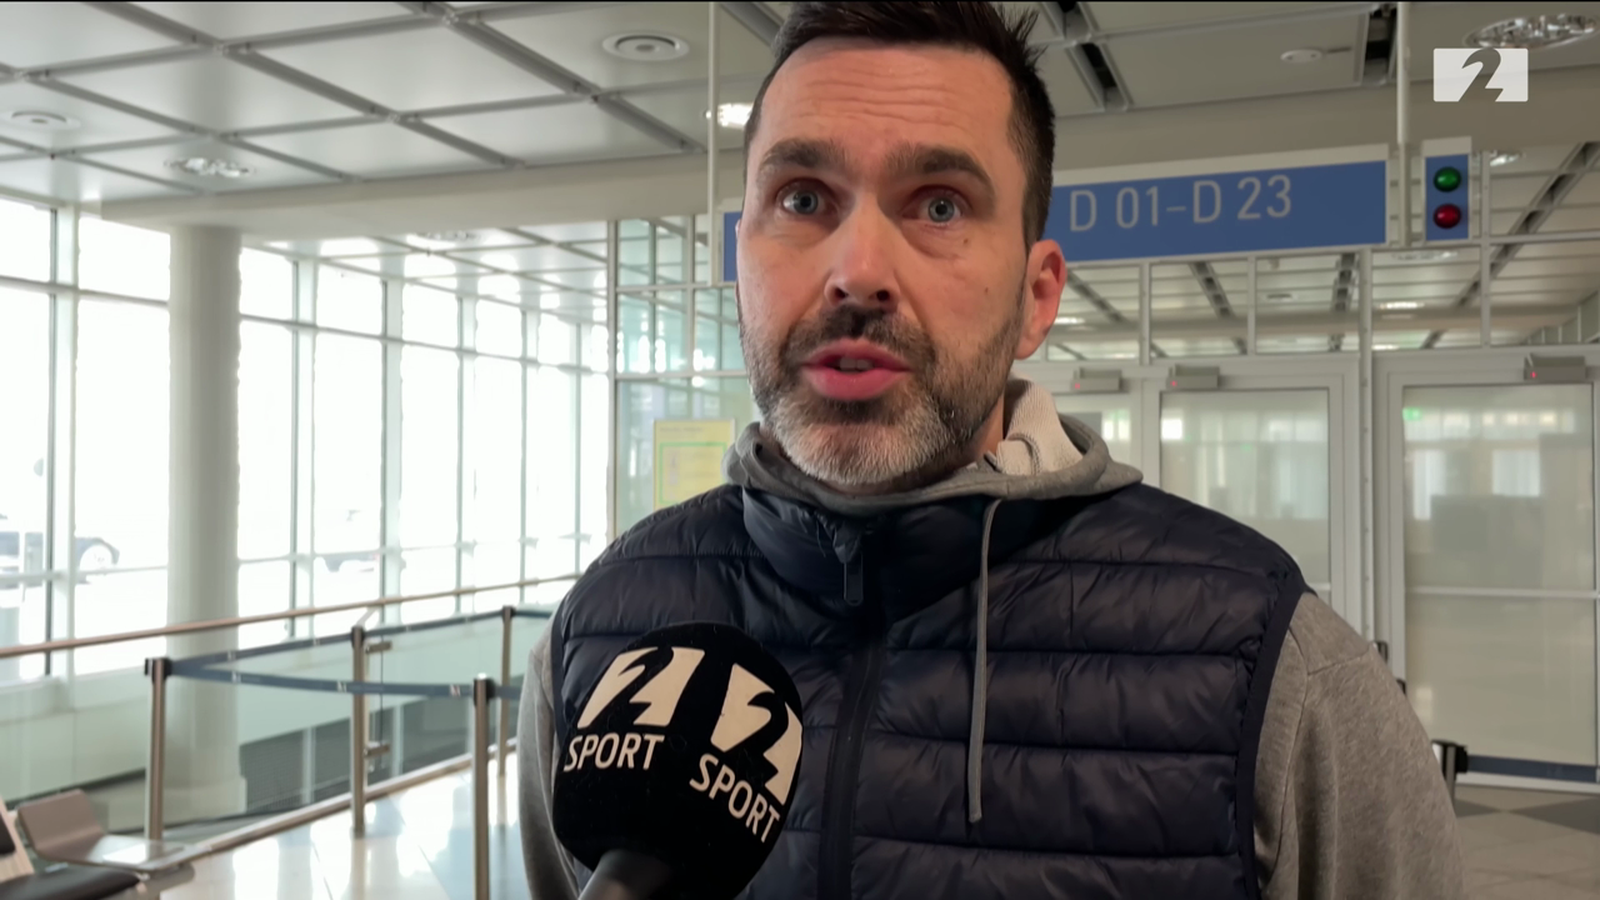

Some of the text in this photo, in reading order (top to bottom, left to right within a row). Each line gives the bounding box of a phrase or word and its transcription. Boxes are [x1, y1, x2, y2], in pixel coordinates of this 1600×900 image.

[1069, 189, 1097, 232] D
[1237, 174, 1291, 220] 23
[587, 647, 676, 728] 2
[563, 732, 665, 772] SPORT
[689, 753, 780, 843] SPORT
